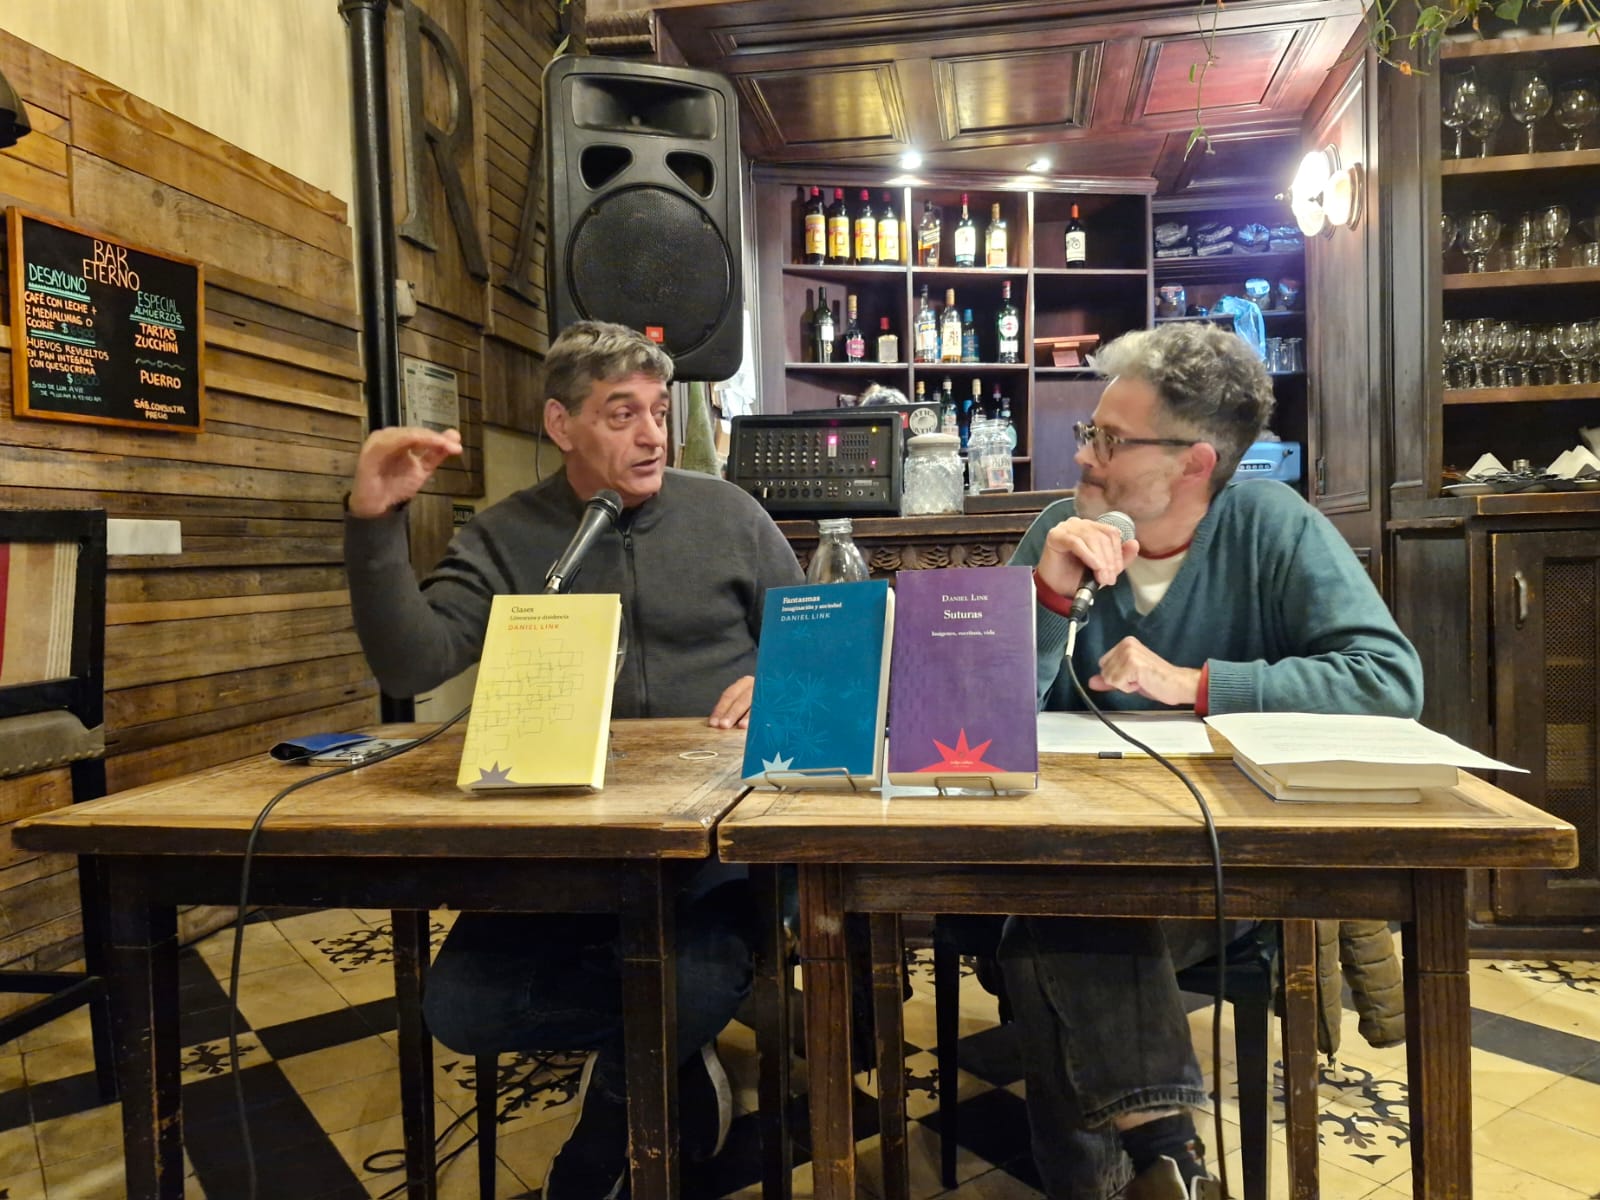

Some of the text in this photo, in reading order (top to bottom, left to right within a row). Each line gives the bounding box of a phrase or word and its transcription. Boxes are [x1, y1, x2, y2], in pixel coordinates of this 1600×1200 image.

[94, 240, 129, 271] BAR
[28, 263, 87, 293] DESAYUNO
[83, 259, 140, 291] ETERNO
[24, 291, 46, 305] CAFÉ
[46, 296, 64, 308] CON
[64, 300, 89, 314] LECHE
[137, 290, 180, 315] ESPECIAL
[134, 305, 183, 325] ALMUERZOS
[139, 322, 177, 341] TARTAS
[26, 335, 110, 361] HUEVOS REVUELTOS
[29, 358, 45, 368] CON
[39, 350, 55, 360] PAN
[57, 354, 95, 367] INTEGRAL
[140, 369, 181, 389] PUERRO
[783, 596, 820, 604] Fantasmas
[780, 612, 831, 622] DANIEL LINK
[943, 609, 983, 620] Suturas
[507, 623, 538, 631] DANIEL
